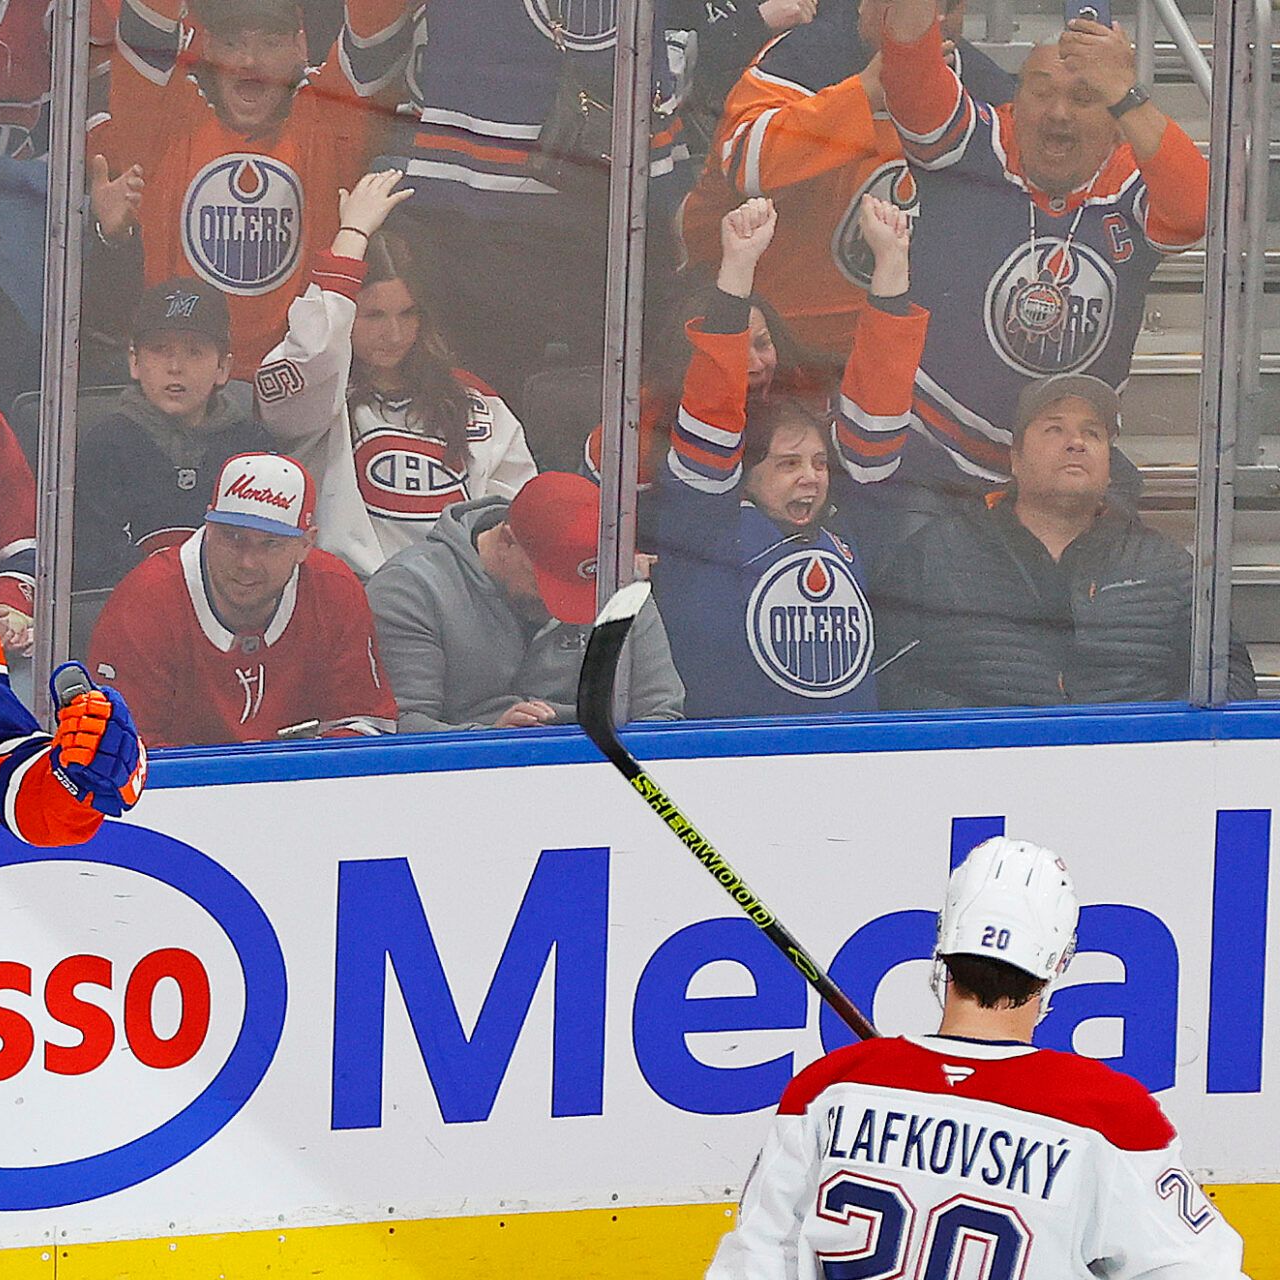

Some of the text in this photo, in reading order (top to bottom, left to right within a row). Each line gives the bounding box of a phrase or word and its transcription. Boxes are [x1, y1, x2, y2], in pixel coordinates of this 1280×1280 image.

[200, 205, 293, 242] OILERS
[1103, 212, 1134, 263] C
[770, 606, 860, 643] OILERS
[631, 772, 776, 929] SHERWOOD
[981, 925, 1011, 951] 20
